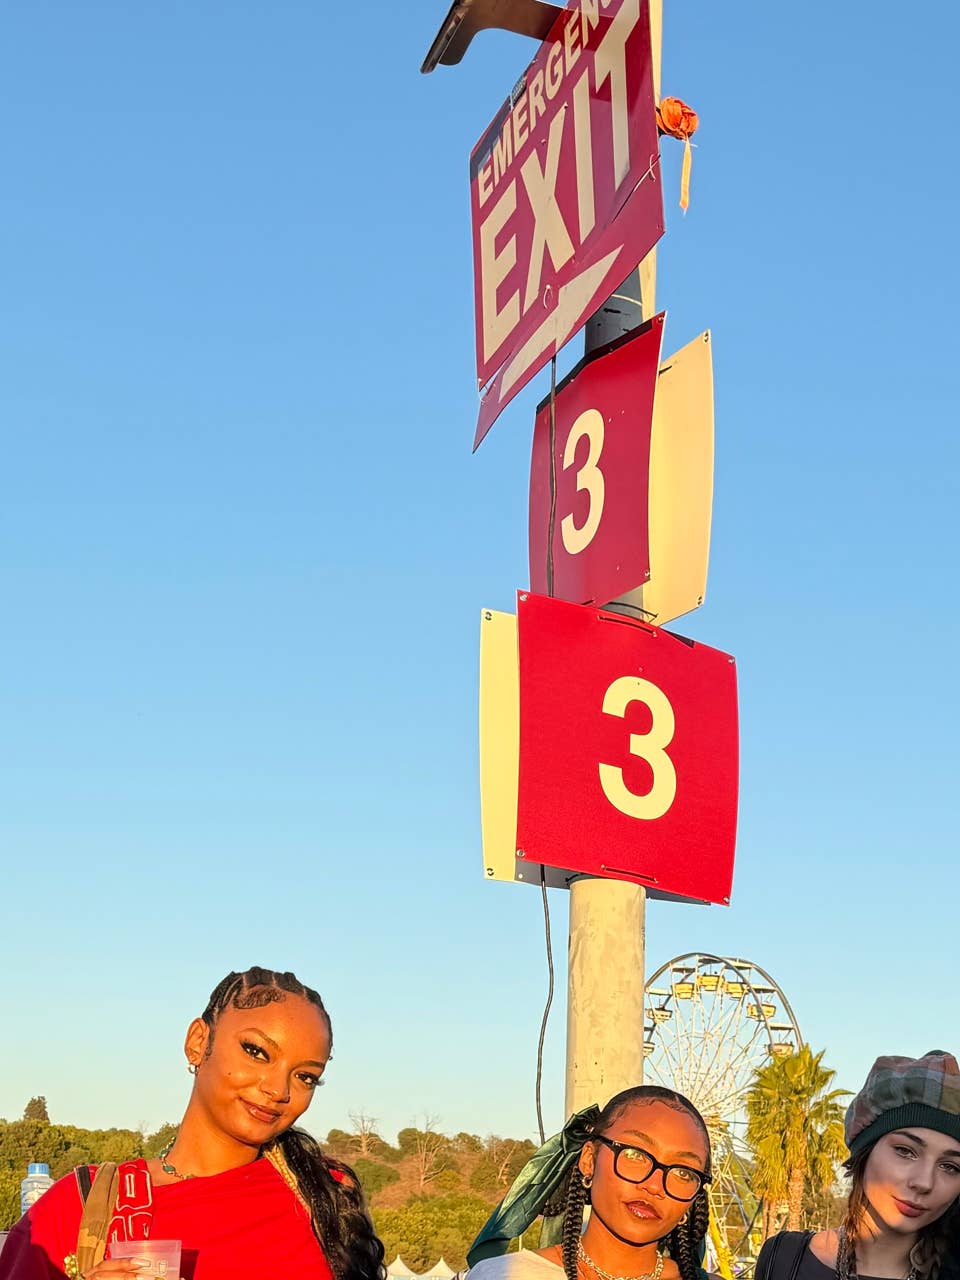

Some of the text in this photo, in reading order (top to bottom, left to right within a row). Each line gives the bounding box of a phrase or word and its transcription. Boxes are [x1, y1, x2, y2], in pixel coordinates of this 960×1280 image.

[478, 0, 611, 208] EMERGEN
[480, 0, 640, 365] EXIT
[560, 408, 606, 555] 3
[598, 676, 677, 821] 3
